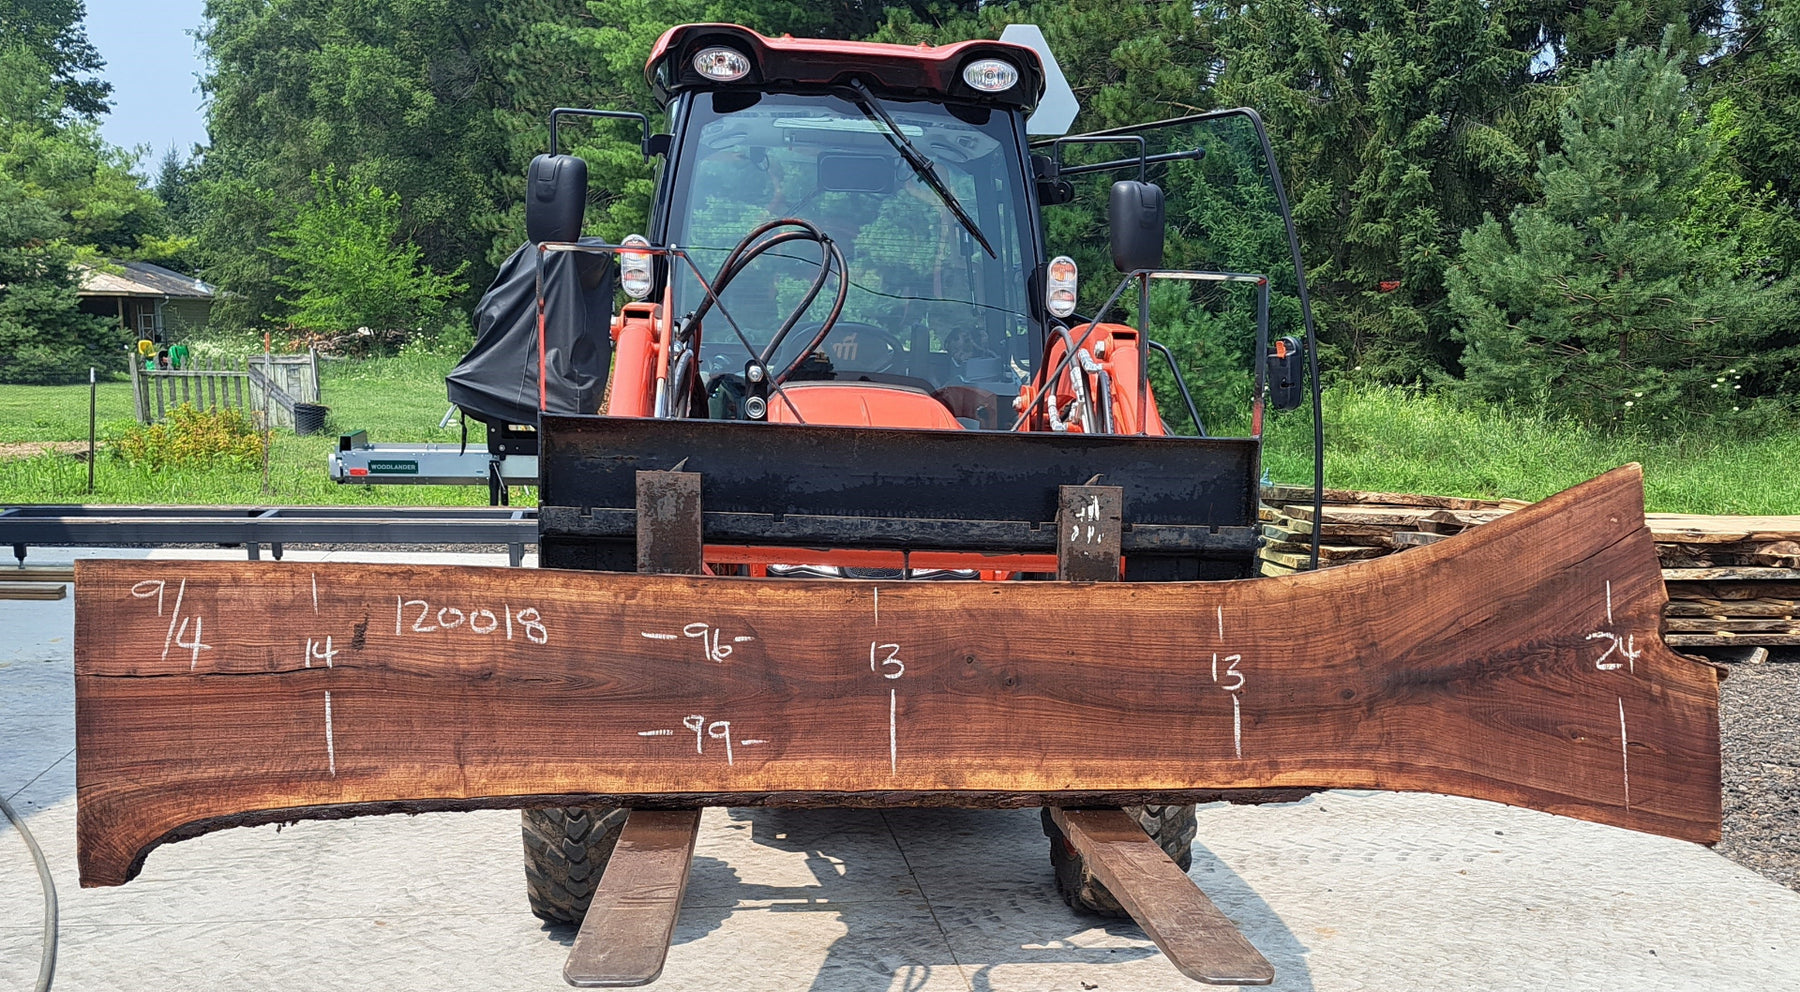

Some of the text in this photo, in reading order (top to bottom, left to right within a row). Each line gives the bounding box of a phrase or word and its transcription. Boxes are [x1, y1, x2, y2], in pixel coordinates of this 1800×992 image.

[131, 577, 212, 670] 9/4
[395, 594, 548, 645] 120018
[305, 634, 339, 668] 14
[869, 641, 905, 679] 13
[1211, 652, 1246, 690] 13
[1586, 631, 1641, 675] 24
